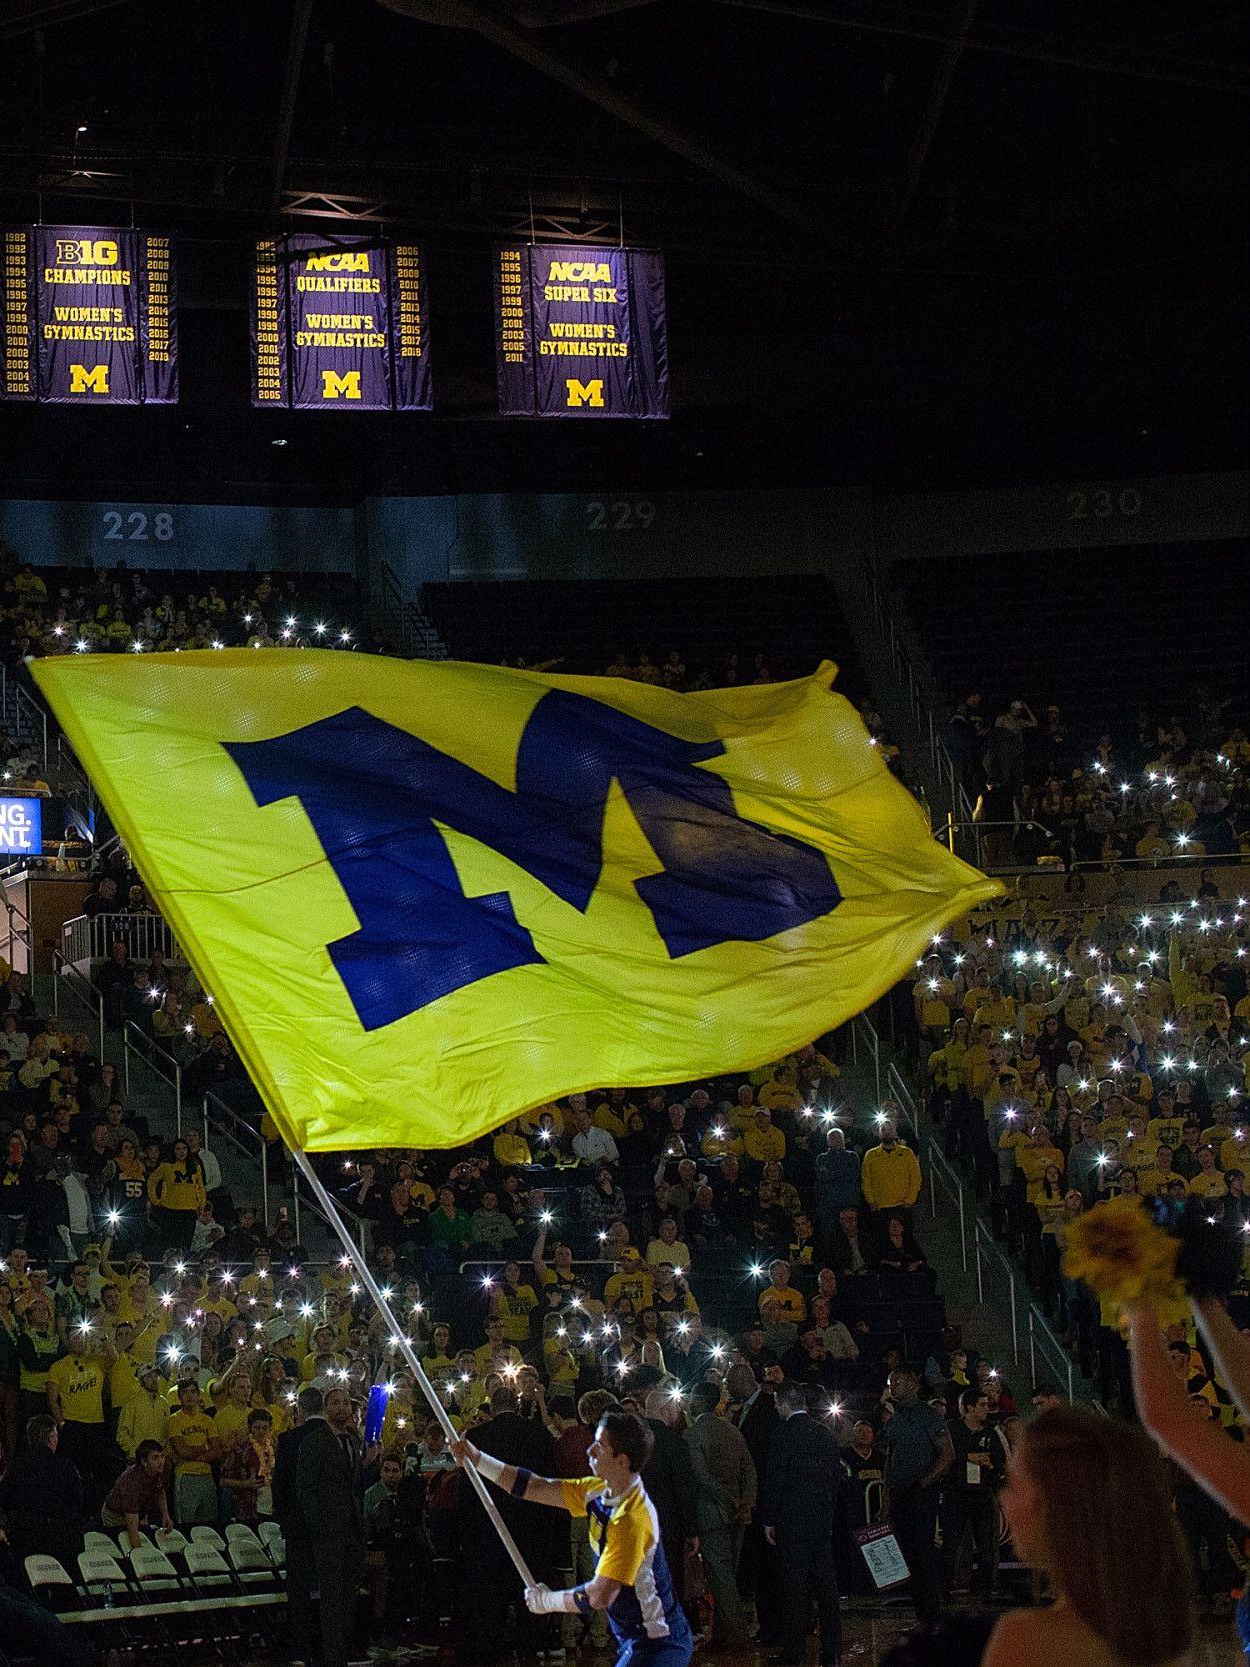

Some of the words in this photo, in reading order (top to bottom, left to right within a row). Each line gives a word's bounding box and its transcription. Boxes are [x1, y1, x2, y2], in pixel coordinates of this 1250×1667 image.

[6, 245, 26, 253] 1992
[6, 256, 26, 265] 1993
[500, 252, 521, 260] 1994
[306, 253, 370, 272] NCAA
[6, 268, 26, 276] 1994
[501, 263, 521, 272] 1995
[549, 262, 611, 283] NCAA
[45, 269, 131, 286] CHAMPIONS
[257, 276, 276, 285] 1995
[501, 274, 521, 283] 1996
[6, 279, 26, 288] 1995
[297, 276, 380, 293] QUALIFIERS
[257, 288, 277, 296] 1996
[501, 286, 522, 294] 1997
[545, 286, 590, 302] SUPER
[594, 288, 618, 303] SIX
[6, 291, 27, 299] 1996
[258, 299, 277, 308] 1997
[502, 297, 522, 305] 1999
[6, 302, 27, 311] 1997
[54, 307, 123, 322] WOMEN'S
[258, 311, 277, 319] 1998
[501, 308, 523, 317] 2000
[7, 314, 27, 322] 1999
[306, 314, 373, 329] WOMEN'S
[258, 322, 277, 331] 1999
[503, 320, 522, 328] 2001
[6, 326, 28, 334] 2000
[44, 325, 135, 341] GYMNASTICS
[549, 323, 616, 338] WOMEN'S
[257, 334, 279, 342] 2000
[503, 331, 524, 339] 2003
[7, 337, 28, 346] 2001
[297, 332, 385, 348] GYMNASTICS
[259, 345, 278, 354] 2001
[503, 342, 524, 350] 2005
[540, 341, 628, 357] GYMNASTICS
[6, 349, 28, 357] 2002
[505, 353, 523, 362] 2011
[7, 360, 29, 369] 2003
[258, 356, 280, 365] 2002
[7, 372, 29, 380] 2004
[258, 368, 280, 376] 2003
[70, 365, 109, 393] M
[258, 379, 280, 388] 2004
[7, 383, 29, 392] 2005
[322, 371, 361, 399] M
[259, 391, 280, 399] 2005
[566, 379, 604, 407] M
[1067, 488, 1143, 520] 230
[586, 501, 655, 529] 229
[102, 511, 175, 541] 228
[221, 688, 842, 1032] M
[174, 1170, 193, 1183] M
[125, 1181, 143, 1198] 55
